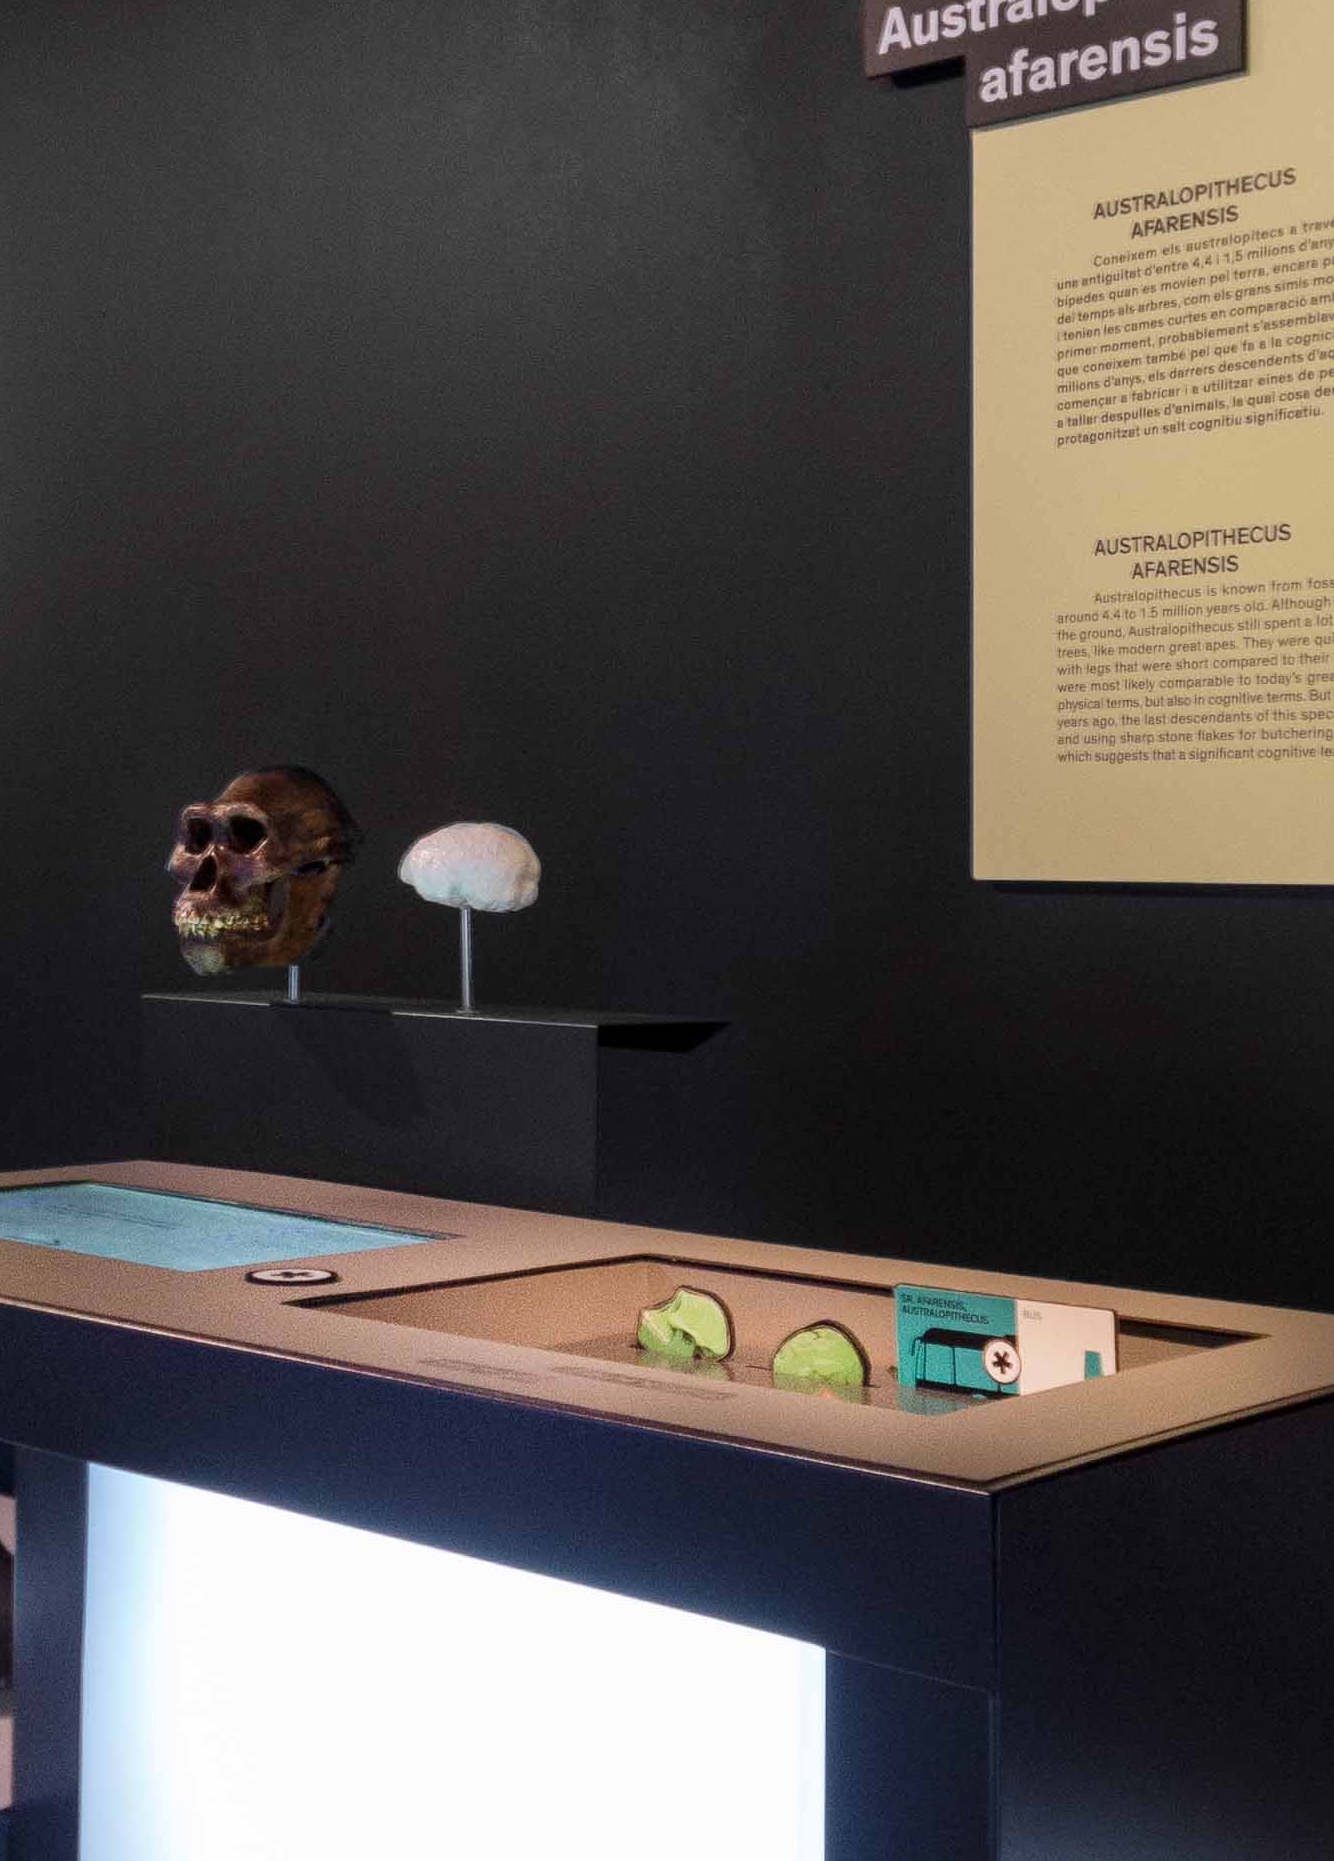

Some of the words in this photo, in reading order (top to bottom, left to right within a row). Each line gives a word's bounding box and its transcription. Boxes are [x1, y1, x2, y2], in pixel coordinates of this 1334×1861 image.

[978, 11, 1220, 104] afarensis
[1093, 167, 1297, 220] AUSTRALOPITHECUS
[1130, 204, 1240, 240] AFARENSIS
[1092, 248, 1157, 267] Coneixem
[1161, 243, 1180, 256] els
[1185, 227, 1284, 252] australopitecs
[1288, 225, 1297, 234] a
[1055, 345, 1096, 361] primer
[1099, 335, 1154, 353] moment,
[1157, 321, 1249, 347] probablement
[1055, 379, 1100, 393] milions
[1102, 374, 1145, 387] d'anys,
[1147, 369, 1165, 381] els
[1168, 364, 1215, 379] darrers
[1217, 351, 1304, 372] descendents
[1055, 395, 1116, 411] començar
[1119, 393, 1127, 403] a
[1130, 387, 1179, 401] fabricar
[1183, 383, 1188, 395] i
[1190, 384, 1199, 394] a
[1202, 378, 1252, 392] utilitzar
[1256, 373, 1293, 385] eines
[1296, 368, 1314, 380] de
[1055, 419, 1064, 428] a
[1065, 414, 1097, 427] tallar
[1100, 407, 1160, 423] despulles
[1162, 398, 1228, 415] d'animals,
[1231, 396, 1243, 407] la
[1246, 391, 1275, 408] qual
[1278, 389, 1310, 401] cosa
[1056, 425, 1140, 448] protagonitzat
[1142, 425, 1159, 435] un
[1161, 419, 1185, 433] salt
[1187, 414, 1242, 431] cognitiu
[1244, 405, 1324, 425] significatiu.
[1094, 523, 1292, 556] AUSTRALOPITHECUS
[1131, 554, 1240, 580] AFARENSIS
[1092, 587, 1201, 604] Australopithecus
[1205, 584, 1217, 596] is
[1221, 583, 1266, 595] known
[1269, 580, 1302, 591] from
[1055, 646, 1090, 659] trees,
[1093, 644, 1114, 656] like
[1117, 642, 1165, 655] modern
[1168, 639, 1201, 654] great
[1204, 640, 1239, 652] apes.
[1244, 636, 1273, 649] They
[1276, 636, 1310, 646] were
[1055, 662, 1082, 675] with
[1085, 662, 1111, 676] legs
[1113, 660, 1138, 672] that
[1141, 661, 1171, 671] were
[1174, 656, 1208, 669] short
[1211, 653, 1278, 669] compared
[1280, 653, 1295, 664] to
[1297, 651, 1329, 663] their
[1056, 717, 1088, 730] years
[1091, 717, 1118, 728] ago,
[1120, 713, 1140, 725] the
[1143, 712, 1166, 724] last
[1169, 710, 1252, 723] descendants
[1254, 709, 1269, 721] of
[1271, 709, 1296, 720] this
[1056, 733, 1080, 745] and
[1082, 732, 1116, 746] using
[1119, 731, 1154, 745] sharp
[1157, 730, 1193, 742] stone
[1196, 729, 1234, 740] flakes
[1237, 728, 1256, 739] for
[1259, 726, 1333, 740] butchering
[1056, 750, 1092, 762] which
[1093, 749, 1149, 763] suggests
[1151, 748, 1176, 760] that
[1177, 750, 1186, 759] a
[1187, 746, 1254, 761] significant
[1255, 745, 1316, 760] cognitive
[901, 1304, 990, 1325] AUSTRALOPITHECUS
[916, 1294, 967, 1313] AFARENSIS,
